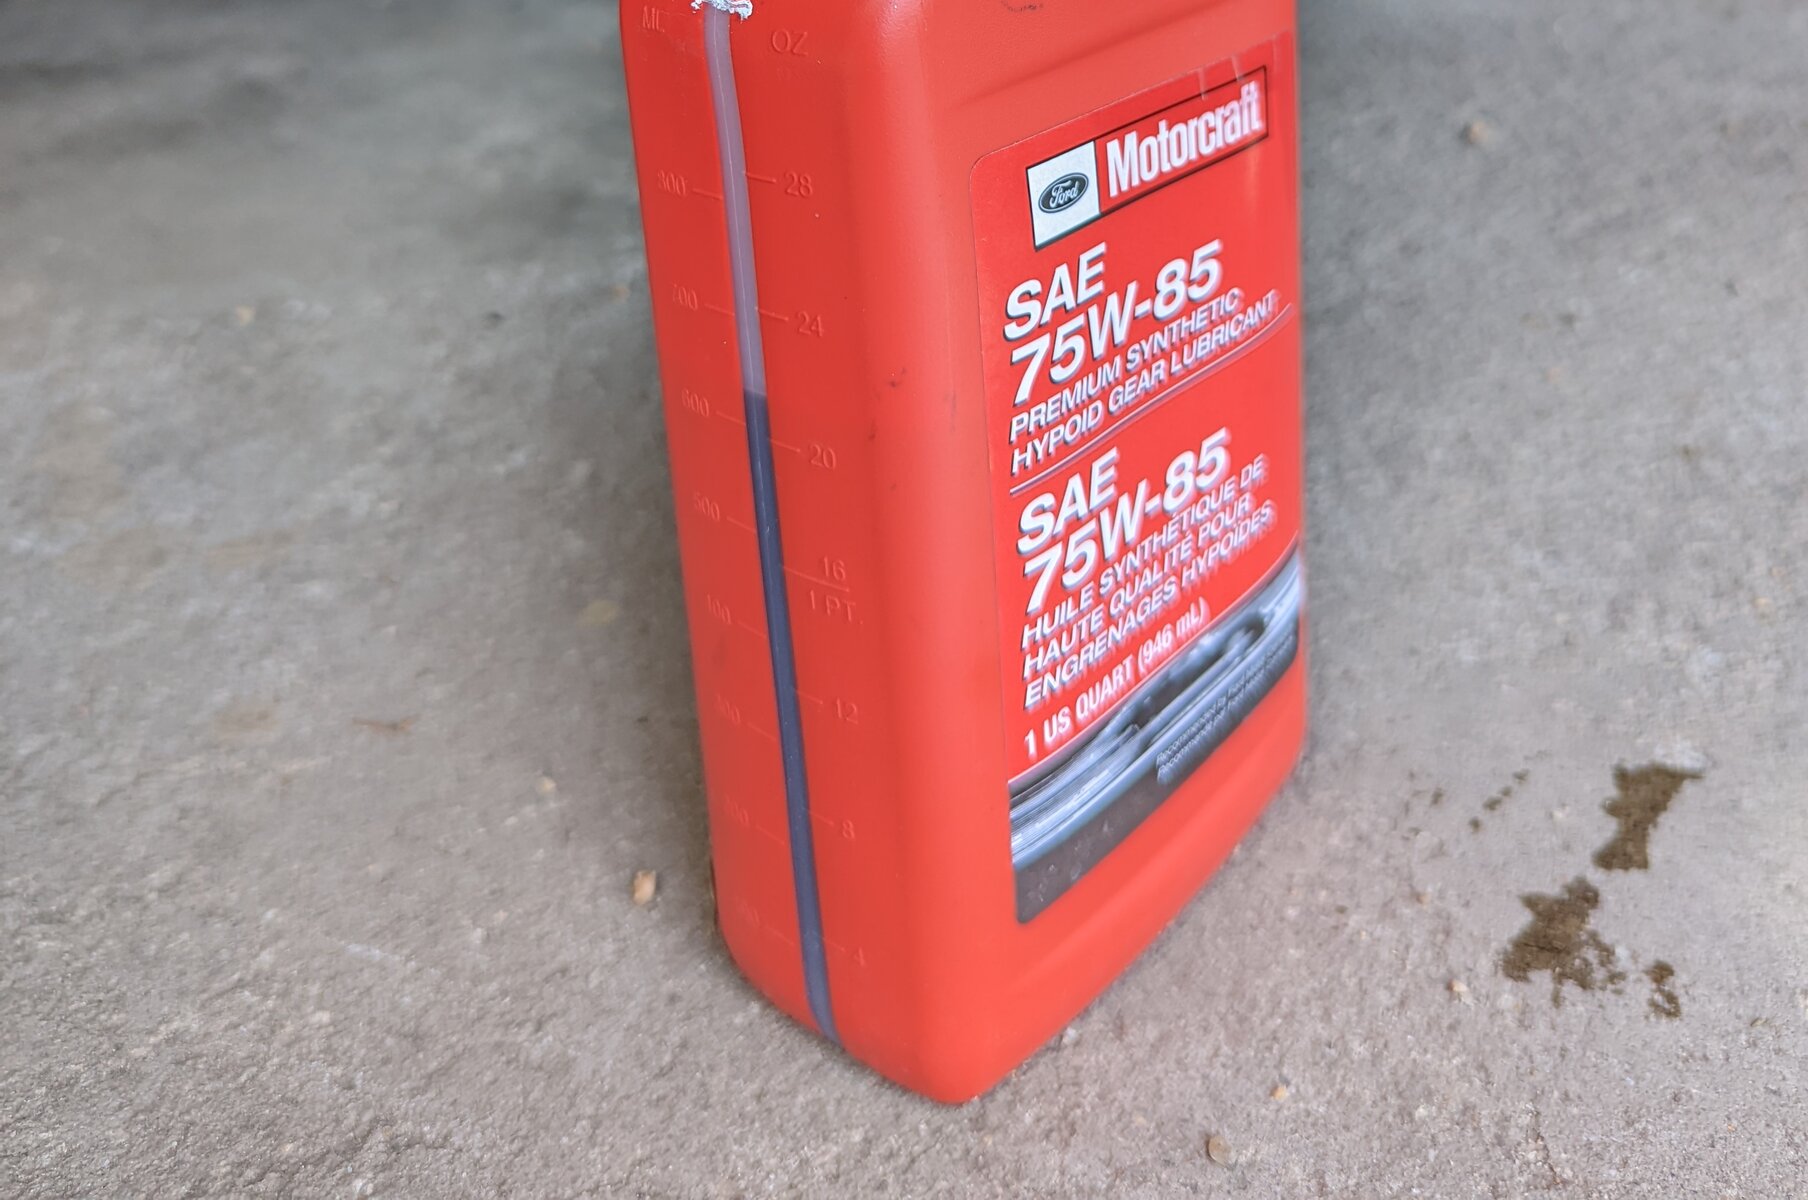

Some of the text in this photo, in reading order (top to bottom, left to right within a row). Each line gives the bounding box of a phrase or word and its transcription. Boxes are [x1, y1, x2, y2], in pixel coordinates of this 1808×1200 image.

[784, 169, 814, 198] 28
[1048, 179, 1080, 209] Ford
[1105, 80, 1262, 199] Motorcraft
[797, 310, 825, 338] 24
[1003, 241, 1107, 342] SAE
[1010, 238, 1223, 408] 75W-85
[1009, 286, 1245, 444] PREMIUM SYNTHETIC
[1010, 289, 1281, 475] HYPOID GEAR LUBRICANT
[809, 442, 837, 471] 20
[1016, 446, 1120, 555] SAE
[823, 555, 846, 581] 16
[1021, 453, 1268, 651] HUILE SYNTHÉTIQUE DE
[1023, 426, 1231, 616] 75W-85
[810, 589, 816, 611] 1
[1022, 491, 1255, 681] HAUTE QUALITÉ POUR
[1023, 575, 1180, 711] ENGRENAGES
[1180, 498, 1276, 589] HYPOÏDES
[835, 696, 859, 725] 12
[1024, 728, 1037, 760] 1
[1043, 710, 1072, 749] US
[1075, 654, 1135, 724] QUART
[1137, 622, 1173, 672] (946
[841, 817, 856, 841] 8
